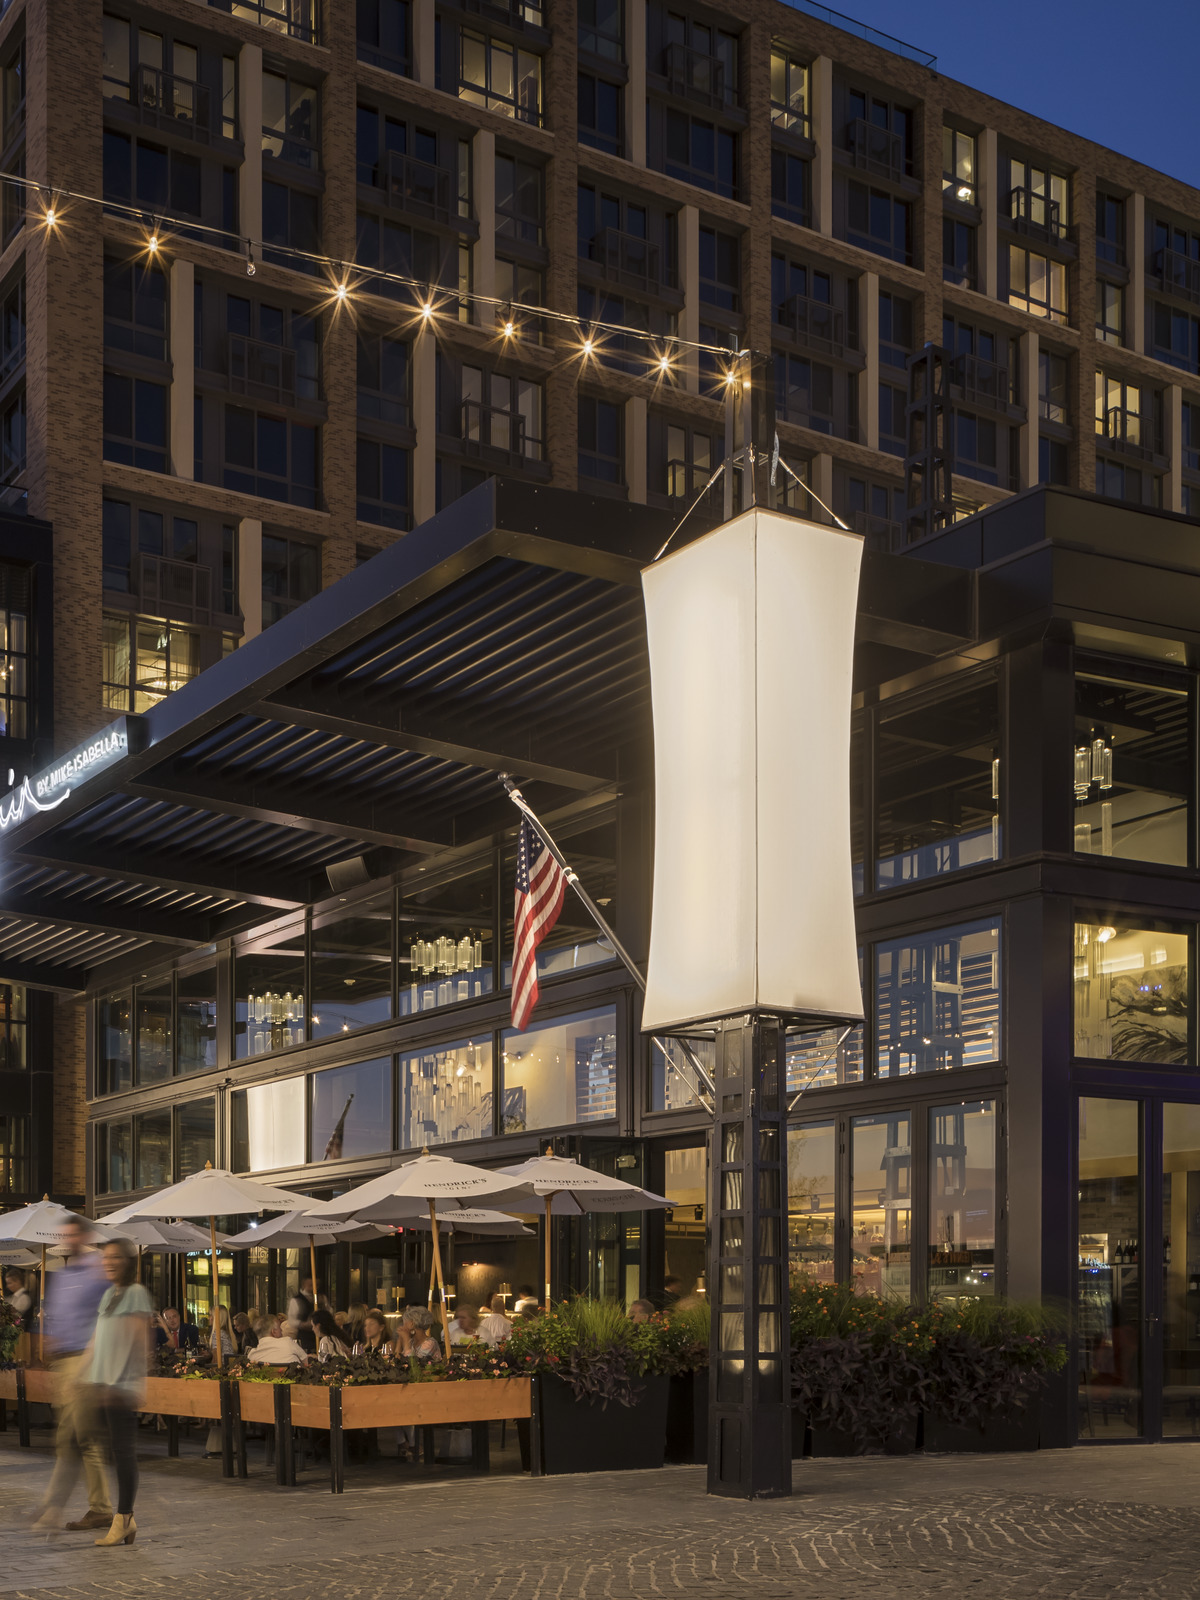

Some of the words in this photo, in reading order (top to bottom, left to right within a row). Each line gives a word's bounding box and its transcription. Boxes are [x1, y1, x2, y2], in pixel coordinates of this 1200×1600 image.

[36, 775, 50, 797] BY
[49, 761, 74, 788] MIKE
[73, 732, 120, 772] ISABELLA
[424, 1178, 487, 1188] HENDRICK'S
